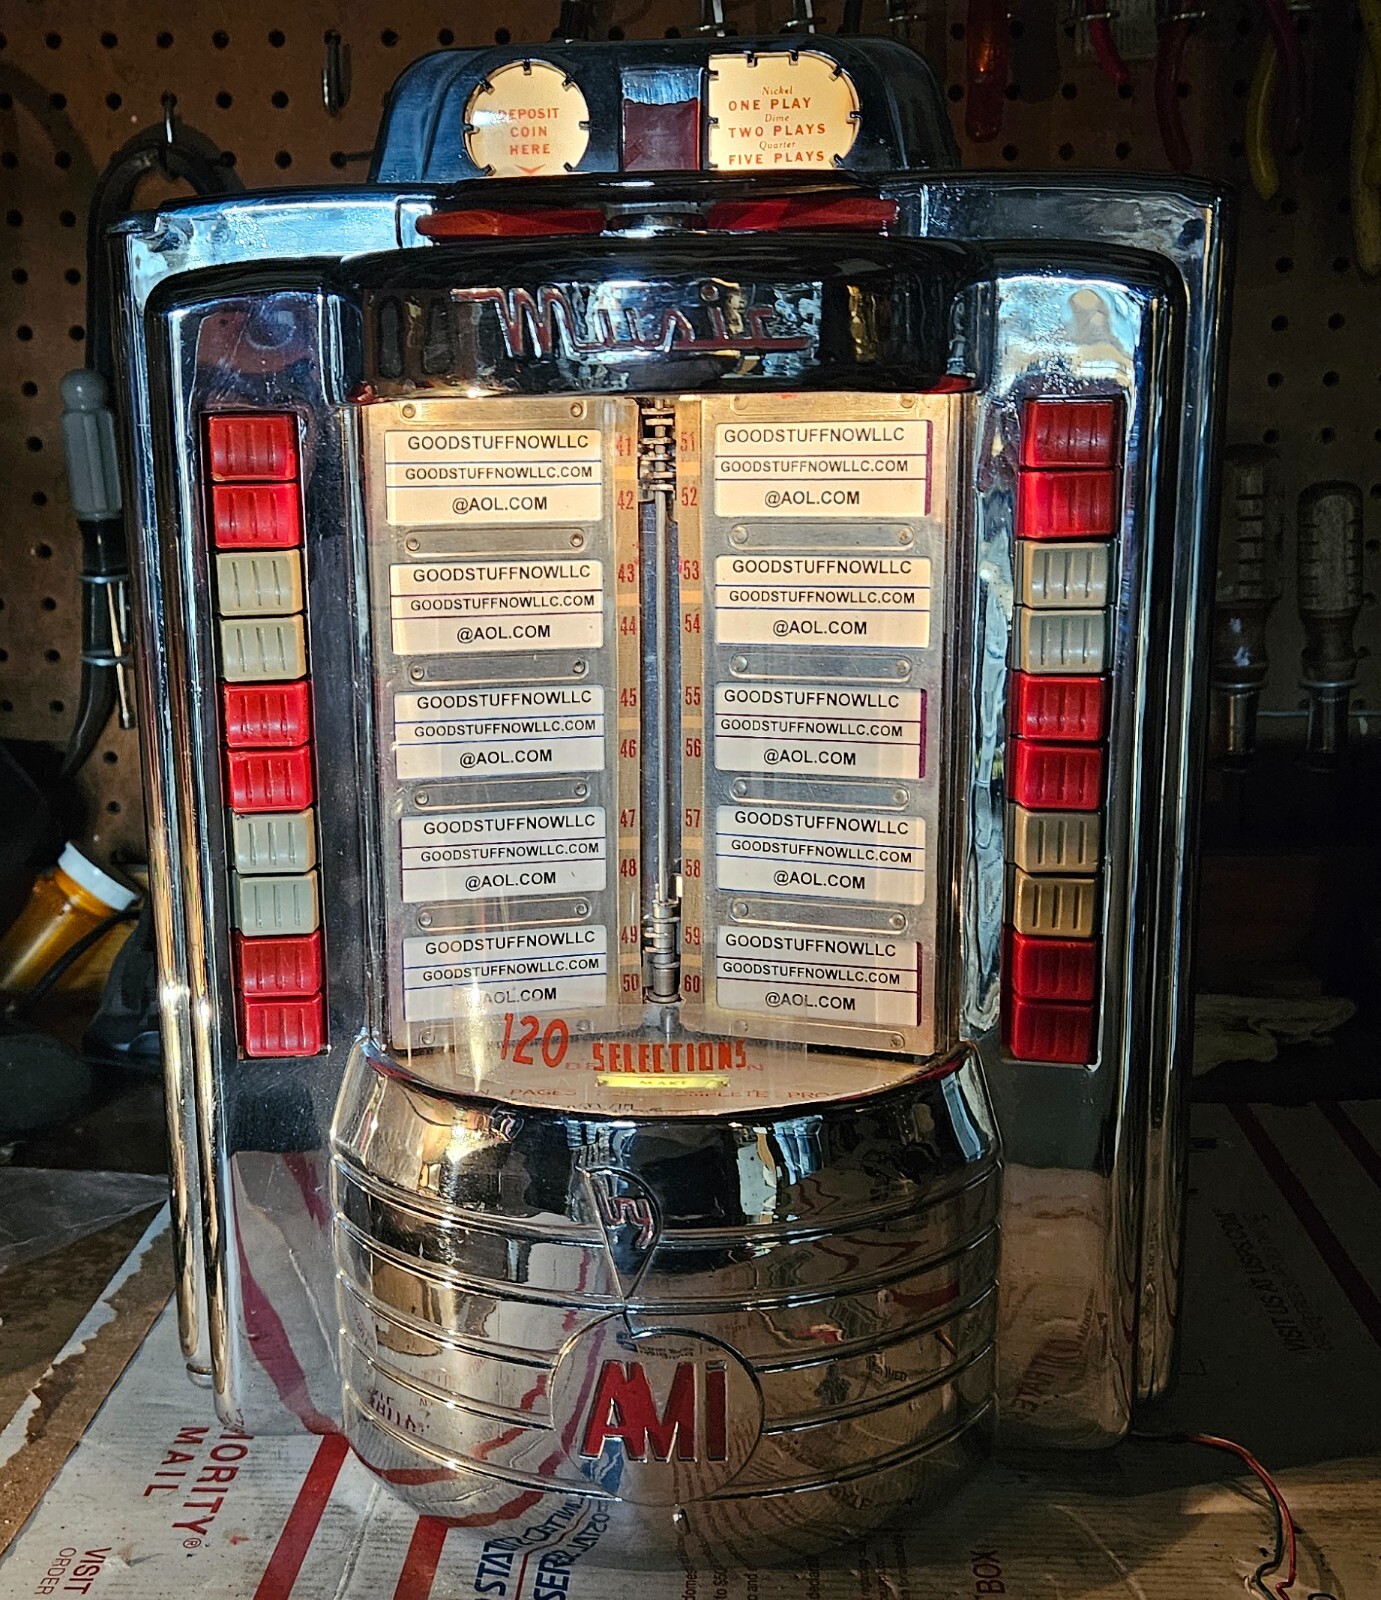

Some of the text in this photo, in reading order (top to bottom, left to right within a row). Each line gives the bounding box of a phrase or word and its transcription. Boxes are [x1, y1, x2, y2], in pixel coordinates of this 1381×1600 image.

[762, 85, 793, 96] Nickel
[728, 97, 811, 111] ONE PLAY
[765, 113, 790, 123] Dime
[510, 126, 548, 138] COIN
[728, 123, 826, 138] TWO PLAYS
[509, 143, 551, 155] HERE
[759, 140, 796, 151] Quarter
[728, 151, 825, 165] FIVE PLAYS
[407, 434, 589, 450] GOODSTUFFNOWLLC
[724, 427, 905, 444] GOODSTUFFNOWLLC
[405, 466, 593, 481] GOODSTUFFNOWLLC.COM
[720, 460, 909, 473] GOODSTUFFNOWLLC.COM
[452, 496, 548, 515] @AOL.COM
[617, 491, 634, 509] 42
[681, 487, 697, 506] 52
[764, 490, 861, 508] @AOL.COM
[413, 565, 591, 582] GOODSTUFFNOWLLC
[618, 564, 635, 583] 43
[683, 561, 699, 580] 53
[732, 560, 912, 575] GOODSTUFFNOWLLC
[410, 595, 595, 612] GOODSTUFFNOWLLC.COM
[729, 590, 915, 604] GOODSTUFFNOWLLC.COM
[620, 616, 637, 635] 44
[685, 614, 700, 633] 54
[772, 619, 868, 637] @AOL.COM
[456, 624, 551, 644] @AOL.COM
[416, 690, 592, 711] GOODSTUFFNOWLLC
[621, 687, 637, 706] 45
[685, 687, 700, 705] 55
[723, 688, 900, 710] GOODSTUFFNOWLLC
[413, 718, 597, 738] GOODSTUFFNOWLLC.COM
[720, 716, 903, 738] GOODSTUFFNOWLLC.COM
[620, 738, 636, 758] 46
[685, 737, 701, 757] 56
[459, 748, 553, 769] @AOL.COM
[762, 748, 857, 767] @AOL.COM
[423, 813, 596, 835] GOODSTUFFNOWLLC
[619, 808, 636, 828] 47
[685, 808, 701, 828] 57
[734, 810, 910, 836] GOODSTUFFNOWLLC
[420, 842, 600, 863] GOODSTUFFNOWLLC.COM
[730, 838, 913, 865] GOODSTUFFNOWLLC.COM
[620, 857, 636, 877] 48
[685, 858, 701, 878] 58
[464, 871, 557, 892] @AOL.COM
[772, 869, 867, 890] @AOL.COM
[424, 930, 596, 955] GOODSTUFFNOWLLC
[621, 925, 637, 945] 49
[685, 926, 701, 945] 59
[724, 933, 897, 958] GOODSTUFFNOWLLC
[422, 958, 600, 983] GOODSTUFFNOWLLC.COM
[722, 961, 901, 986] GOODSTUFFNOWLLC.COM
[623, 973, 638, 993] 50
[684, 974, 701, 994] 60
[484, 987, 557, 1005] AOL.COM
[764, 990, 856, 1012] @AOL.COM
[502, 1013, 746, 1073] 120 SELECTIONS
[579, 1359, 729, 1463] AMI
[143, 1426, 210, 1497] MAIL
[34, 1547, 77, 1595] ORDER
[63, 1547, 112, 1595] VISIT
[970, 1550, 1005, 1594] BOX
